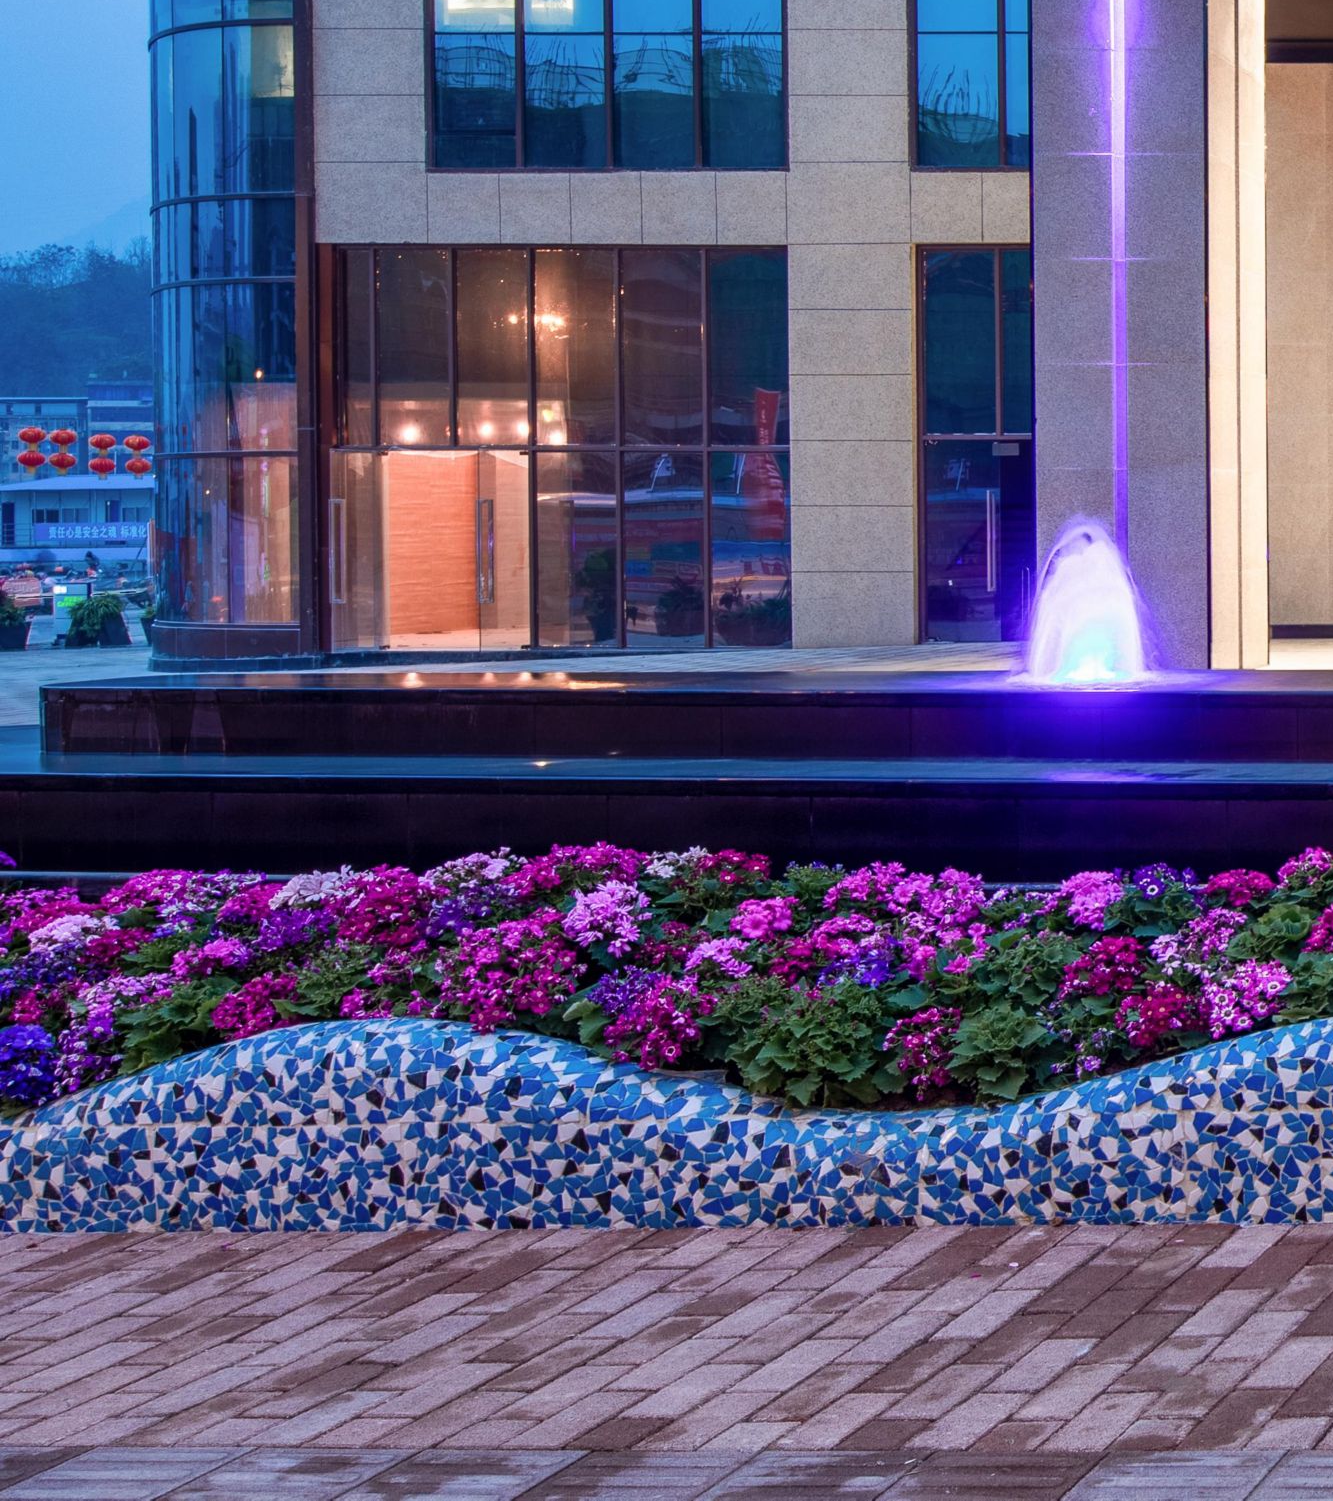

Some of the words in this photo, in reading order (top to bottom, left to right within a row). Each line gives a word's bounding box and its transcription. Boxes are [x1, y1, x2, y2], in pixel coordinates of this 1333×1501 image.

[49, 525, 117, 538] 责任心是安全之魂
[121, 525, 147, 538] 标准化
